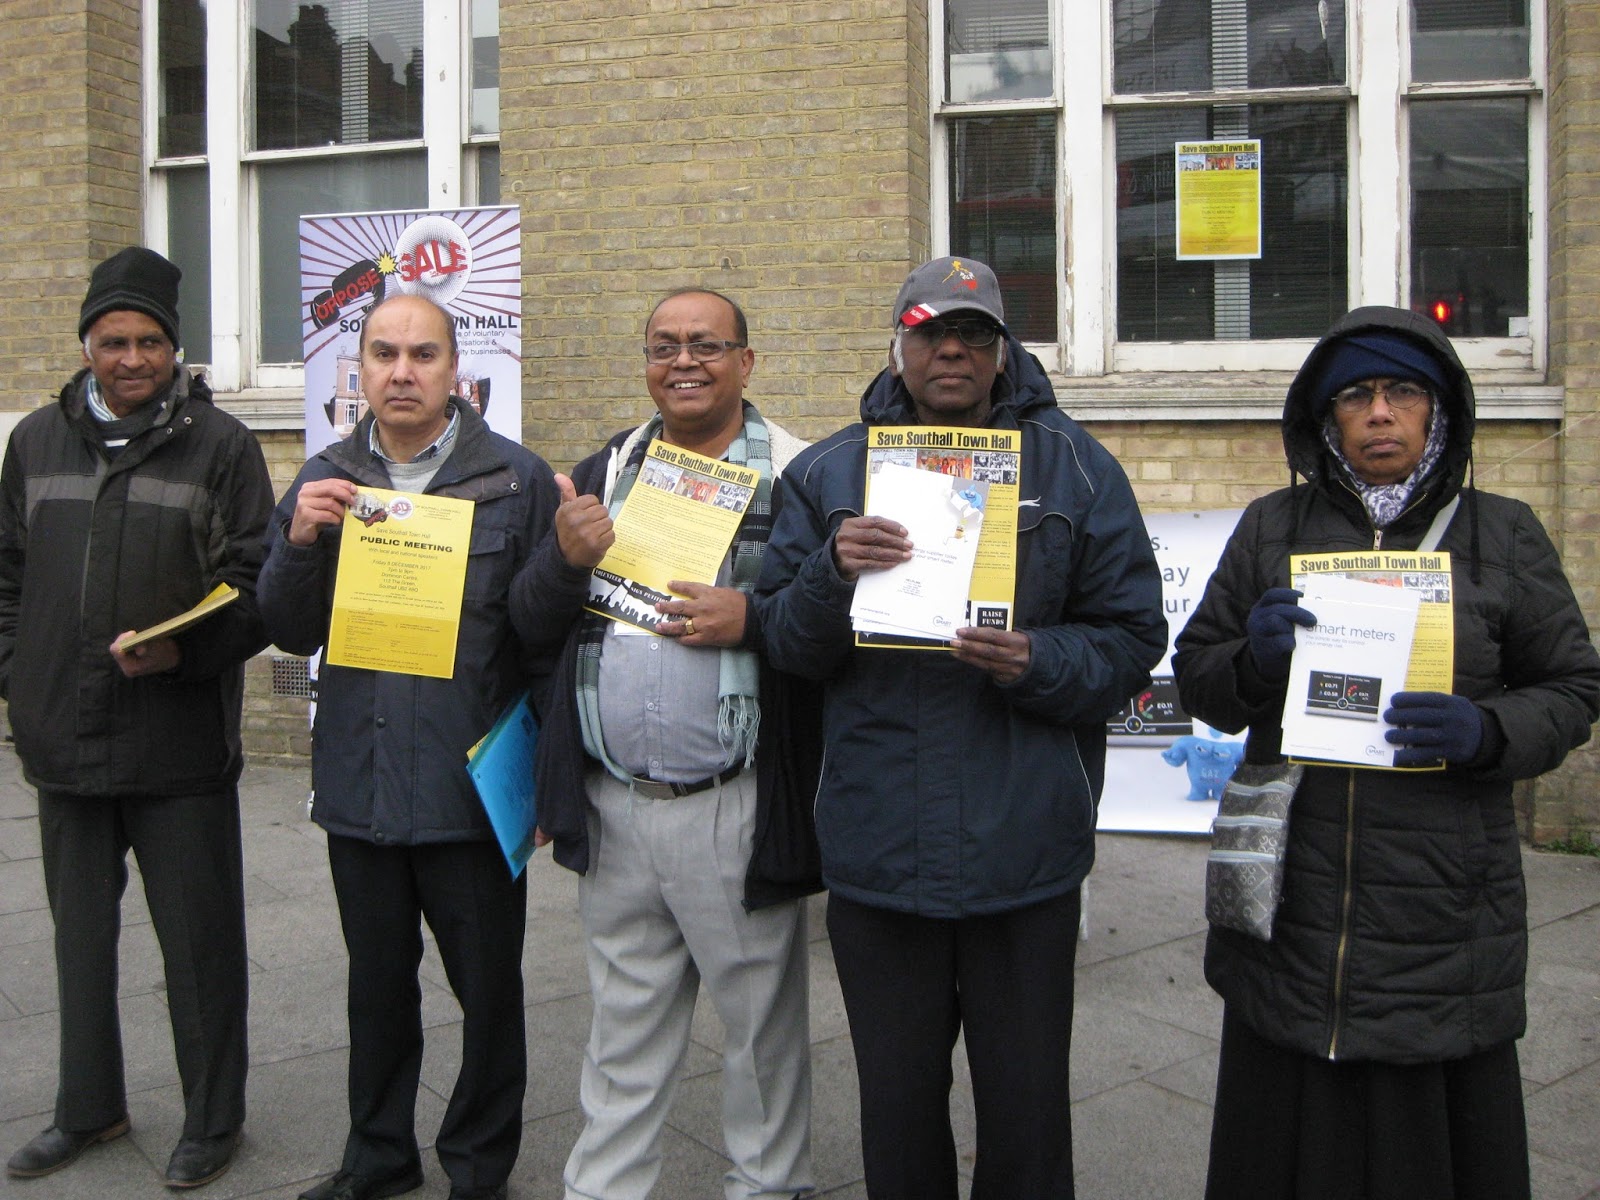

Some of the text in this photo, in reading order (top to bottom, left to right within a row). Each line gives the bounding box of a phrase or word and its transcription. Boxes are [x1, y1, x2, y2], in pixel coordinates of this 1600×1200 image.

[399, 239, 468, 282] SALE
[317, 268, 381, 321] OPPOSE
[340, 319, 365, 333] SO
[475, 315, 518, 330] HALL
[472, 330, 506, 338] voluntary
[877, 431, 1012, 450] Save Southall Town Hall
[654, 445, 678, 463] Save
[678, 453, 714, 474] Southall
[714, 466, 737, 480] Town
[736, 471, 754, 486] Hall
[389, 528, 408, 536] Southall
[360, 536, 453, 553] PUBLIC MEETING
[392, 561, 419, 570] DECEMBER
[1300, 556, 1441, 572] Save Southall Town Hall
[595, 570, 622, 582] VOLUNTEER
[630, 586, 643, 595] SIGN
[1350, 626, 1396, 642] meters
